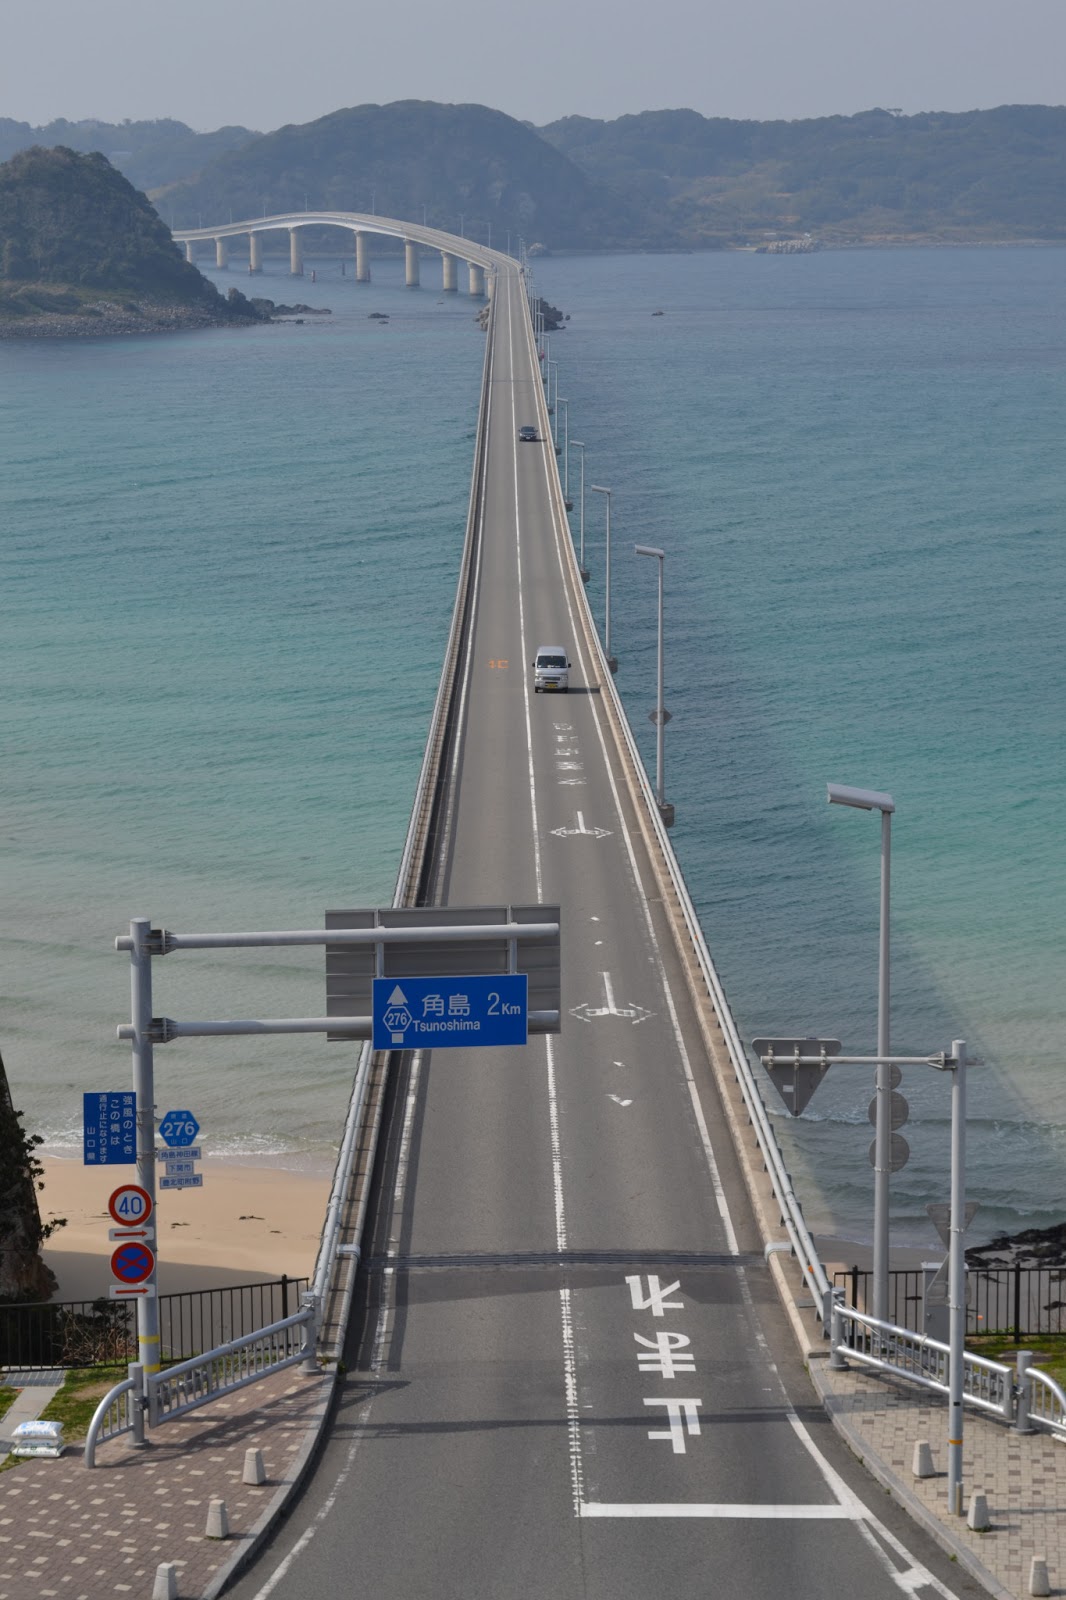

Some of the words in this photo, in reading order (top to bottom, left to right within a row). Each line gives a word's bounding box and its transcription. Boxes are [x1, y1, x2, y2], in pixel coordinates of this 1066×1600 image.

[421, 993, 471, 1018] 角島
[387, 1012, 408, 1026] 276
[412, 1018, 481, 1033] Tsunoshima
[98, 1094, 108, 1164] 通行止になります
[110, 1099, 121, 1146] この橋は
[122, 1095, 133, 1155] 強風のとき
[163, 1121, 195, 1137] 276
[86, 1126, 96, 1161] 山口県
[169, 1164, 191, 1173] 下関市
[118, 1196, 143, 1215] 40
[624, 1274, 703, 1454] 止まれ
